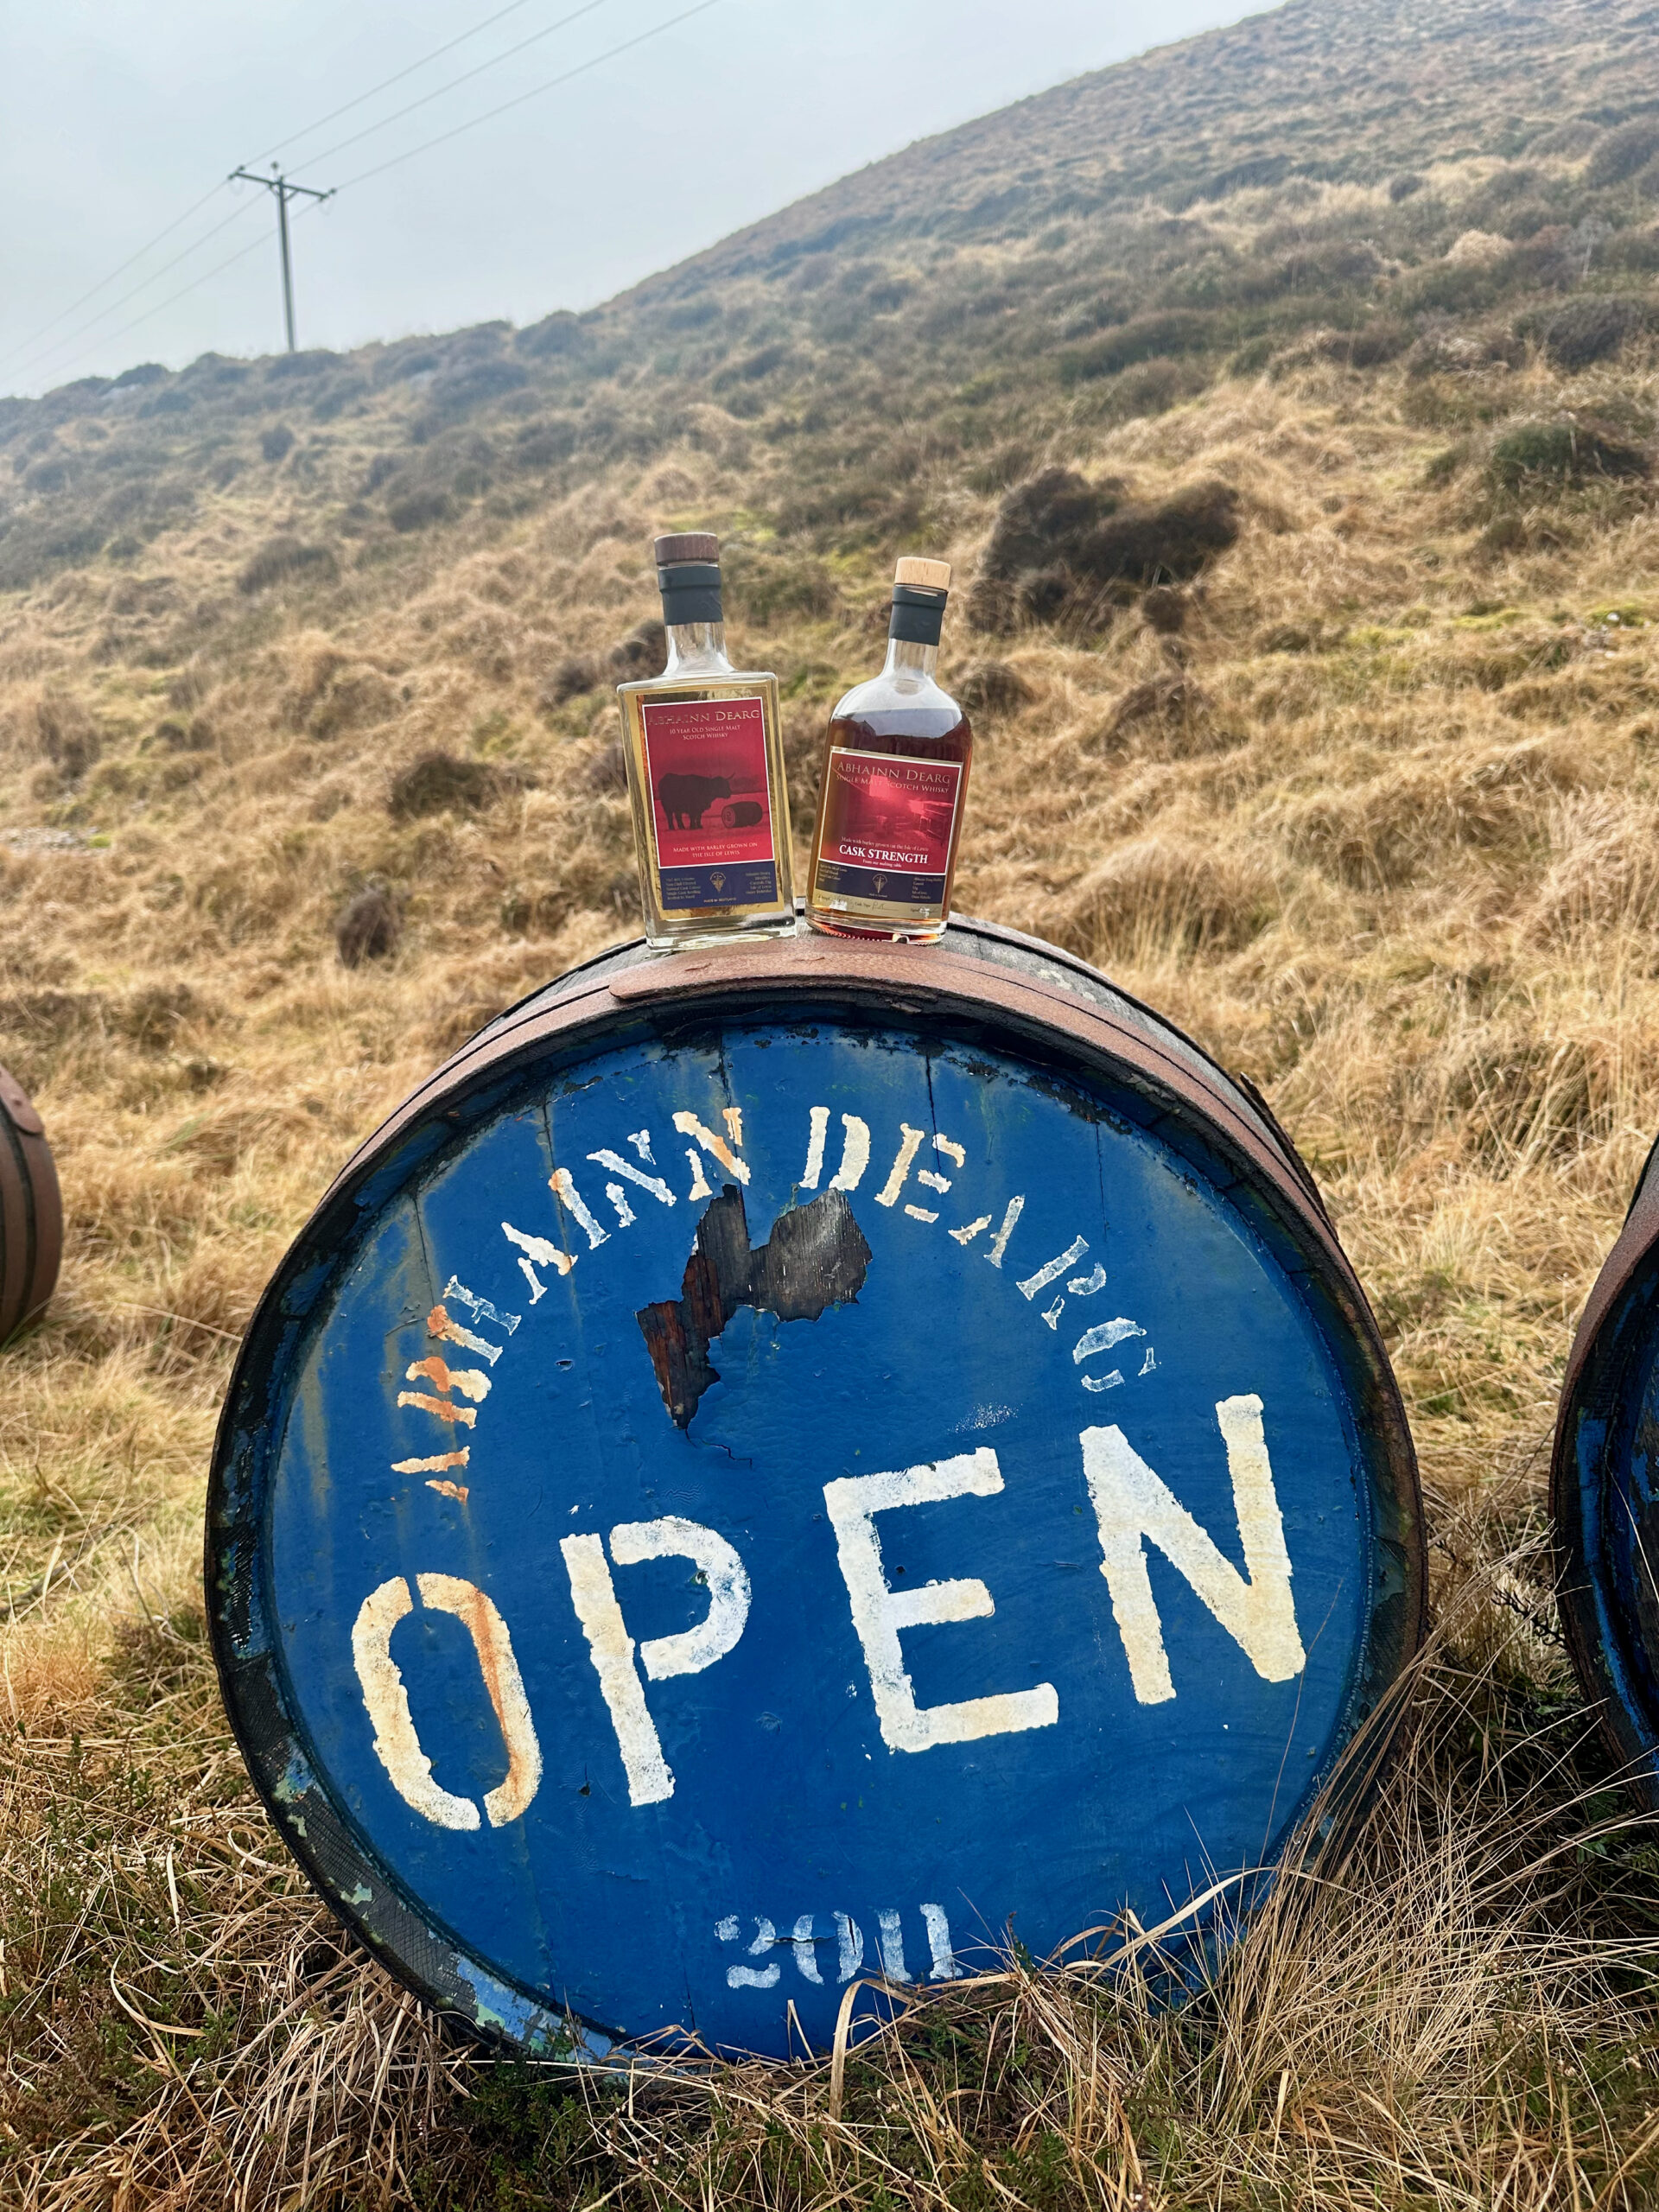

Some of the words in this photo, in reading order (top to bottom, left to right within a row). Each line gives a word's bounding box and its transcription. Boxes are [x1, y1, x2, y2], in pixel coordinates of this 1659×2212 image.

[715, 709, 760, 721] DEARG
[836, 761, 899, 779] ABHAINN
[906, 769, 950, 784] DEARG
[921, 785, 949, 794] WHISKY
[839, 844, 867, 857] CASK
[868, 849, 928, 864] STRENGTH
[799, 1106, 1161, 1392] DEARG
[352, 1393, 1306, 1831] OPEN
[715, 1903, 963, 1990] 2011
